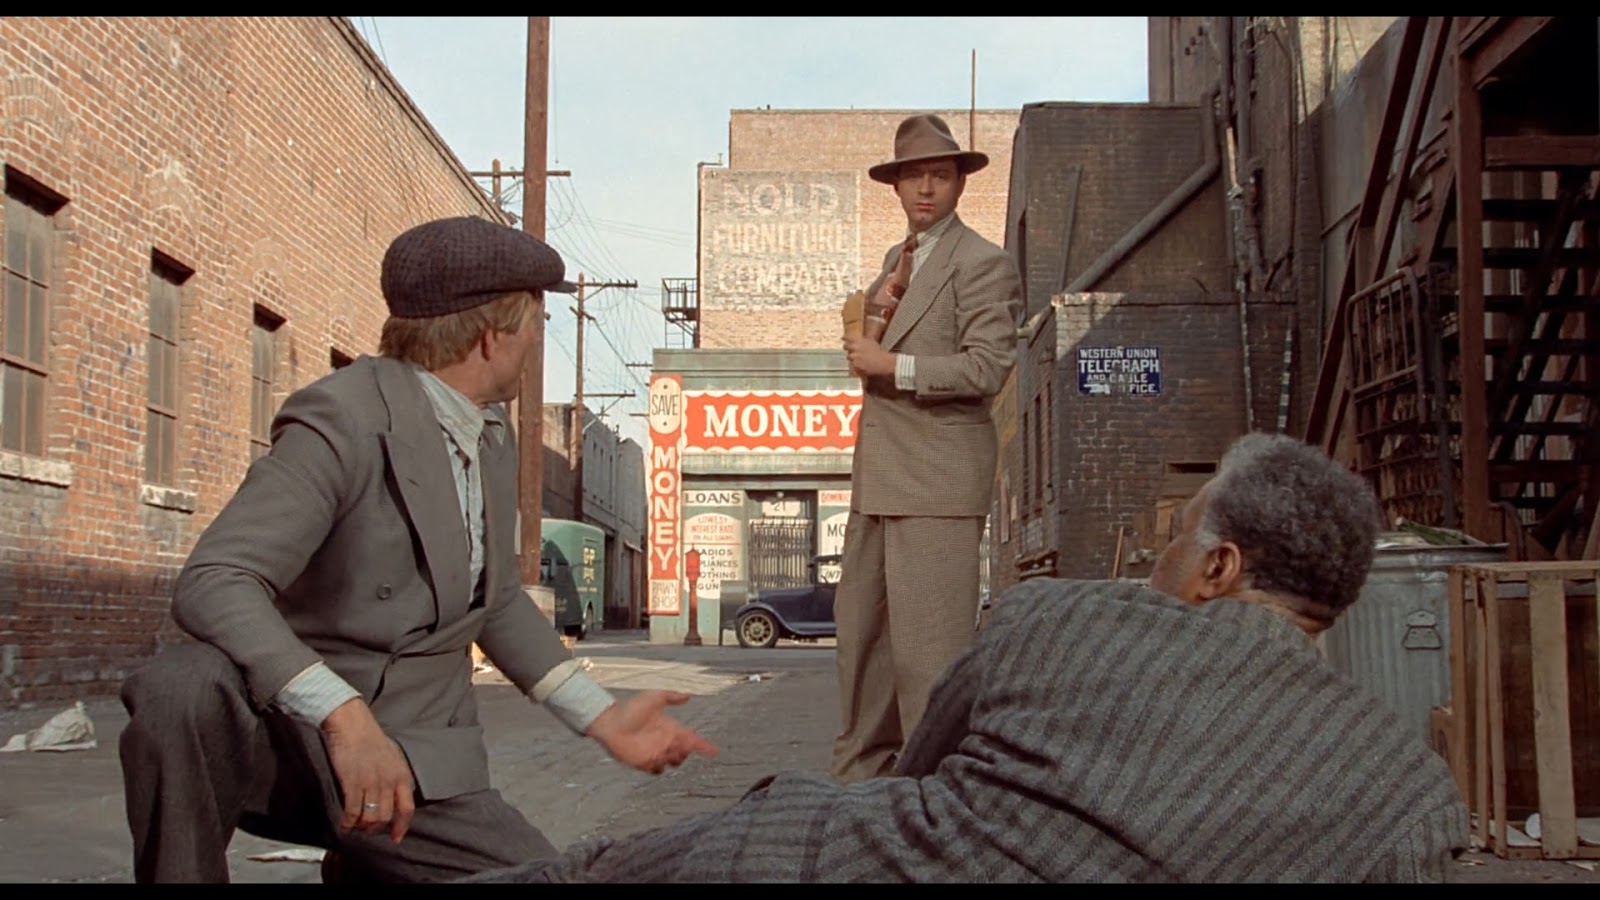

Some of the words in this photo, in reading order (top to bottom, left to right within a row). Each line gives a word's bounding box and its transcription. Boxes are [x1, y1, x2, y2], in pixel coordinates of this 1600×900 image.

[713, 222, 850, 253] FURNITURE
[718, 262, 849, 293] COMPANY
[1079, 348, 1124, 359] WESTERN
[1126, 348, 1157, 358] UNION
[1086, 374, 1106, 382] AND
[651, 394, 679, 416] SAVE
[703, 404, 863, 437] MONEY
[685, 492, 741, 504] LOANS
[654, 446, 676, 571] MONEY
[700, 560, 738, 568] PLIANCES
[700, 571, 737, 579] OTHING
[652, 596, 677, 609] SHOP
